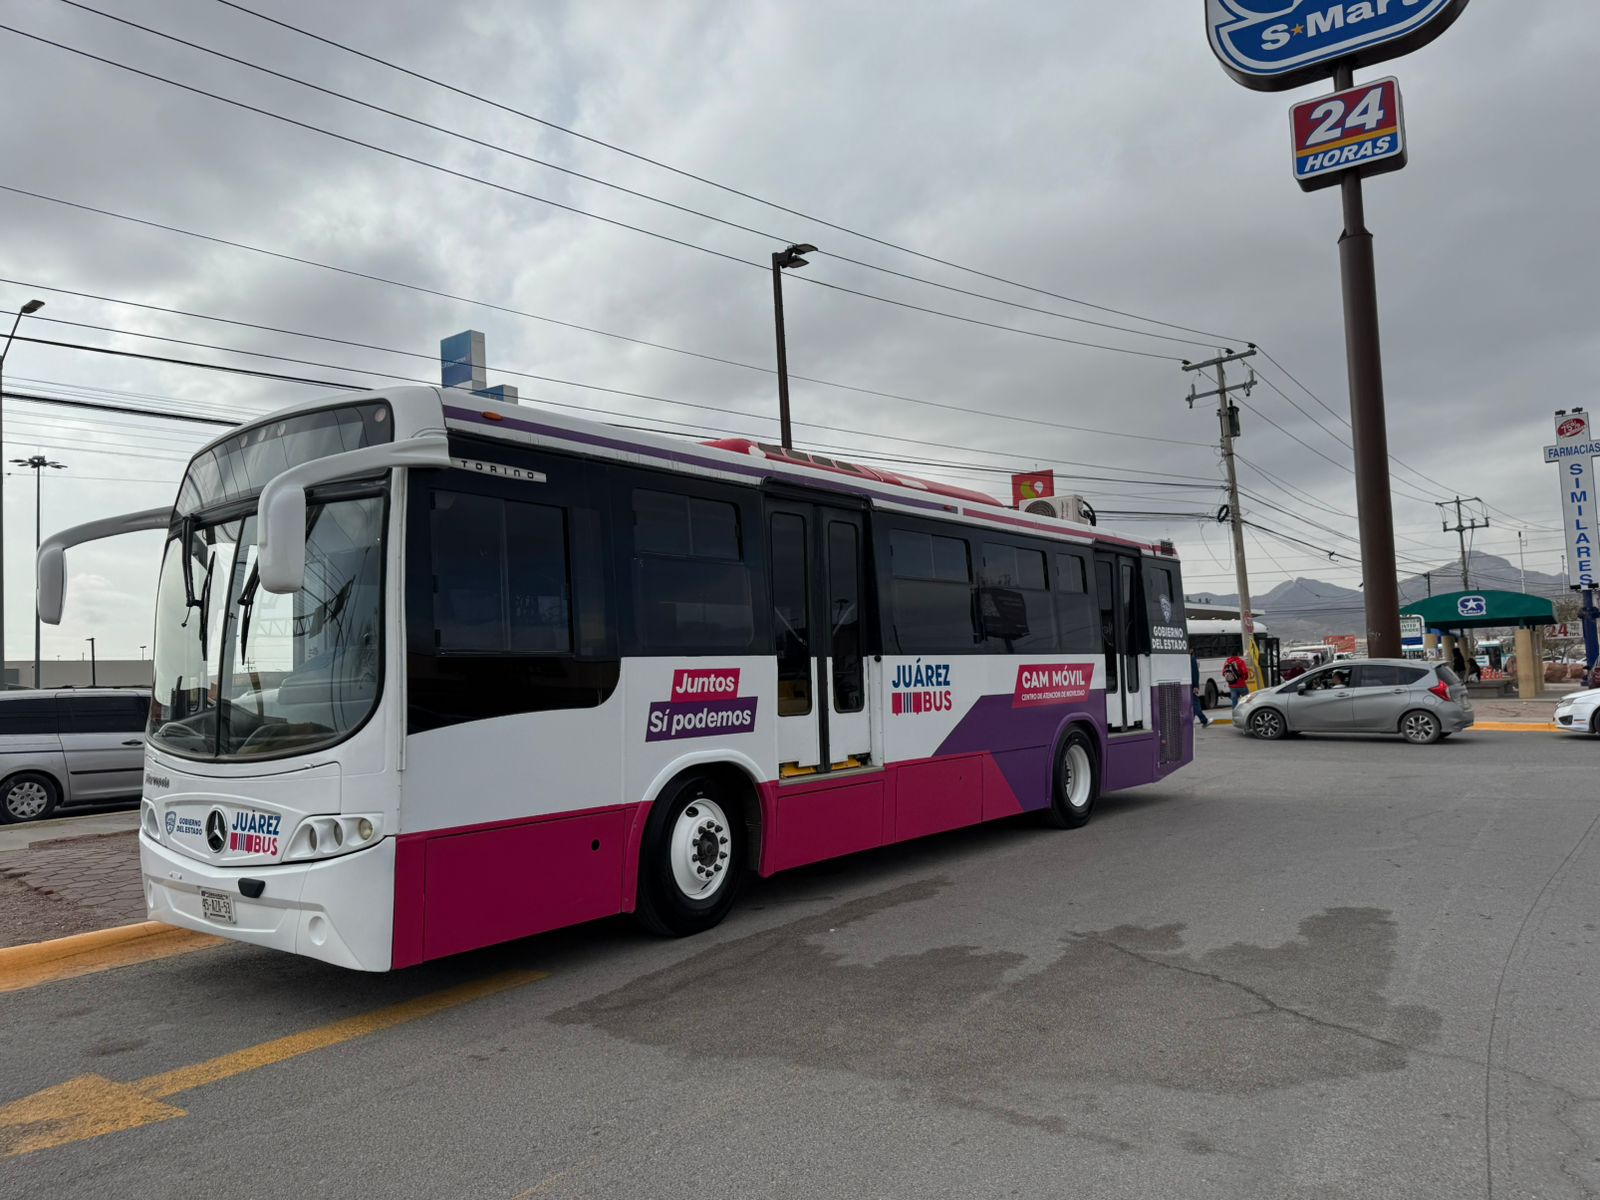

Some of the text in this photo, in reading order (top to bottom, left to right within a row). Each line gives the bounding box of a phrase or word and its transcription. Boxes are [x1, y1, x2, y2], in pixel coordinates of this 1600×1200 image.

[1304, 87, 1385, 146] 24
[1303, 135, 1391, 172] HORAS
[1548, 442, 1600, 459] FARMACIAS
[461, 460, 534, 480] TORINO
[1569, 463, 1594, 587] SIMILARES
[1153, 625, 1184, 639] GOBIERNO
[1151, 638, 1188, 651] DEL ESTADO
[675, 673, 735, 694] Juntos
[892, 657, 950, 688] JUÁREZ
[1022, 665, 1086, 689] CAM MÓVIL
[923, 690, 953, 713] BUS
[649, 707, 752, 736] Sí podemos
[176, 825, 203, 836] DEL ESTADO
[178, 817, 202, 828] GOBIERNO
[232, 809, 282, 836] JUÁREZ
[253, 834, 278, 856] BUS
